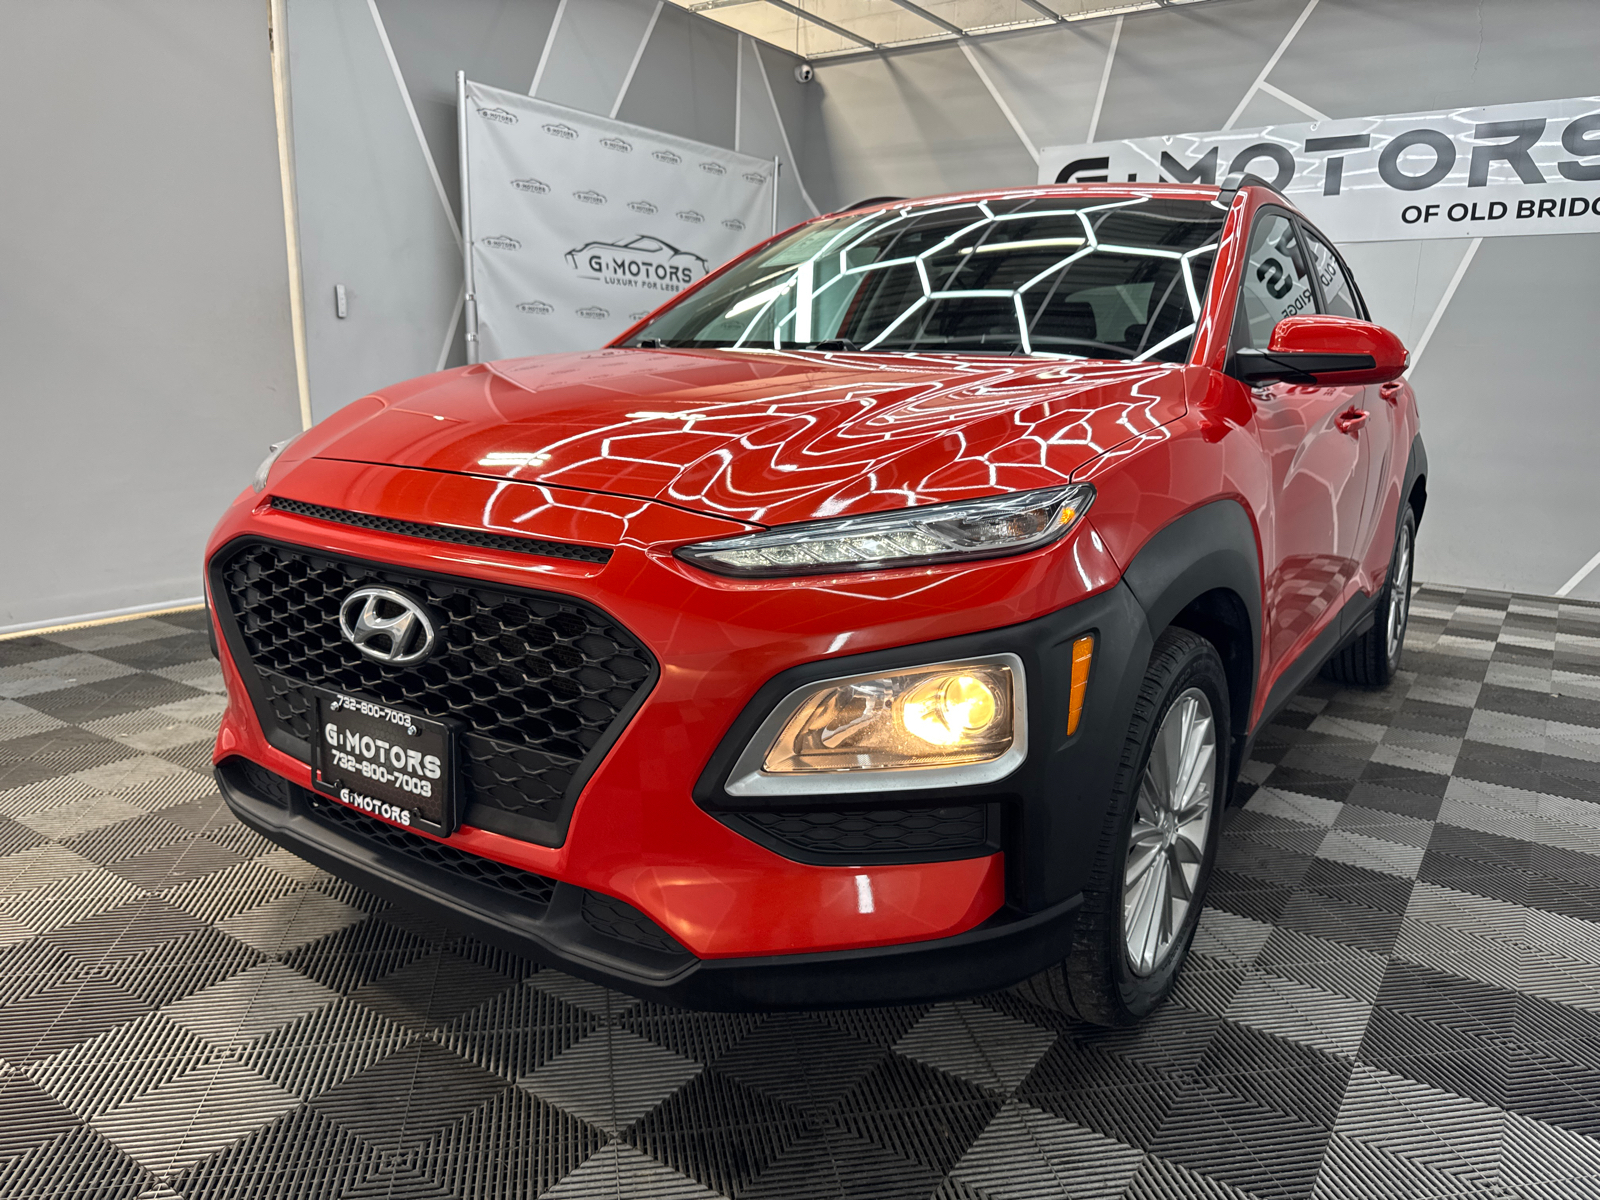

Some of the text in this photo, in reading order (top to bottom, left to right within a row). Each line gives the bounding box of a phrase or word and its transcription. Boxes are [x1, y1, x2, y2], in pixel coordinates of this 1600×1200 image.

[1401, 204, 1440, 224] OF
[1447, 201, 1508, 222] OLD
[604, 276, 638, 288] LUXURY
[642, 281, 658, 290] FOR
[661, 285, 680, 293] LESS
[337, 695, 412, 727] 732-800-7003
[331, 749, 432, 798] 732-800-7003
